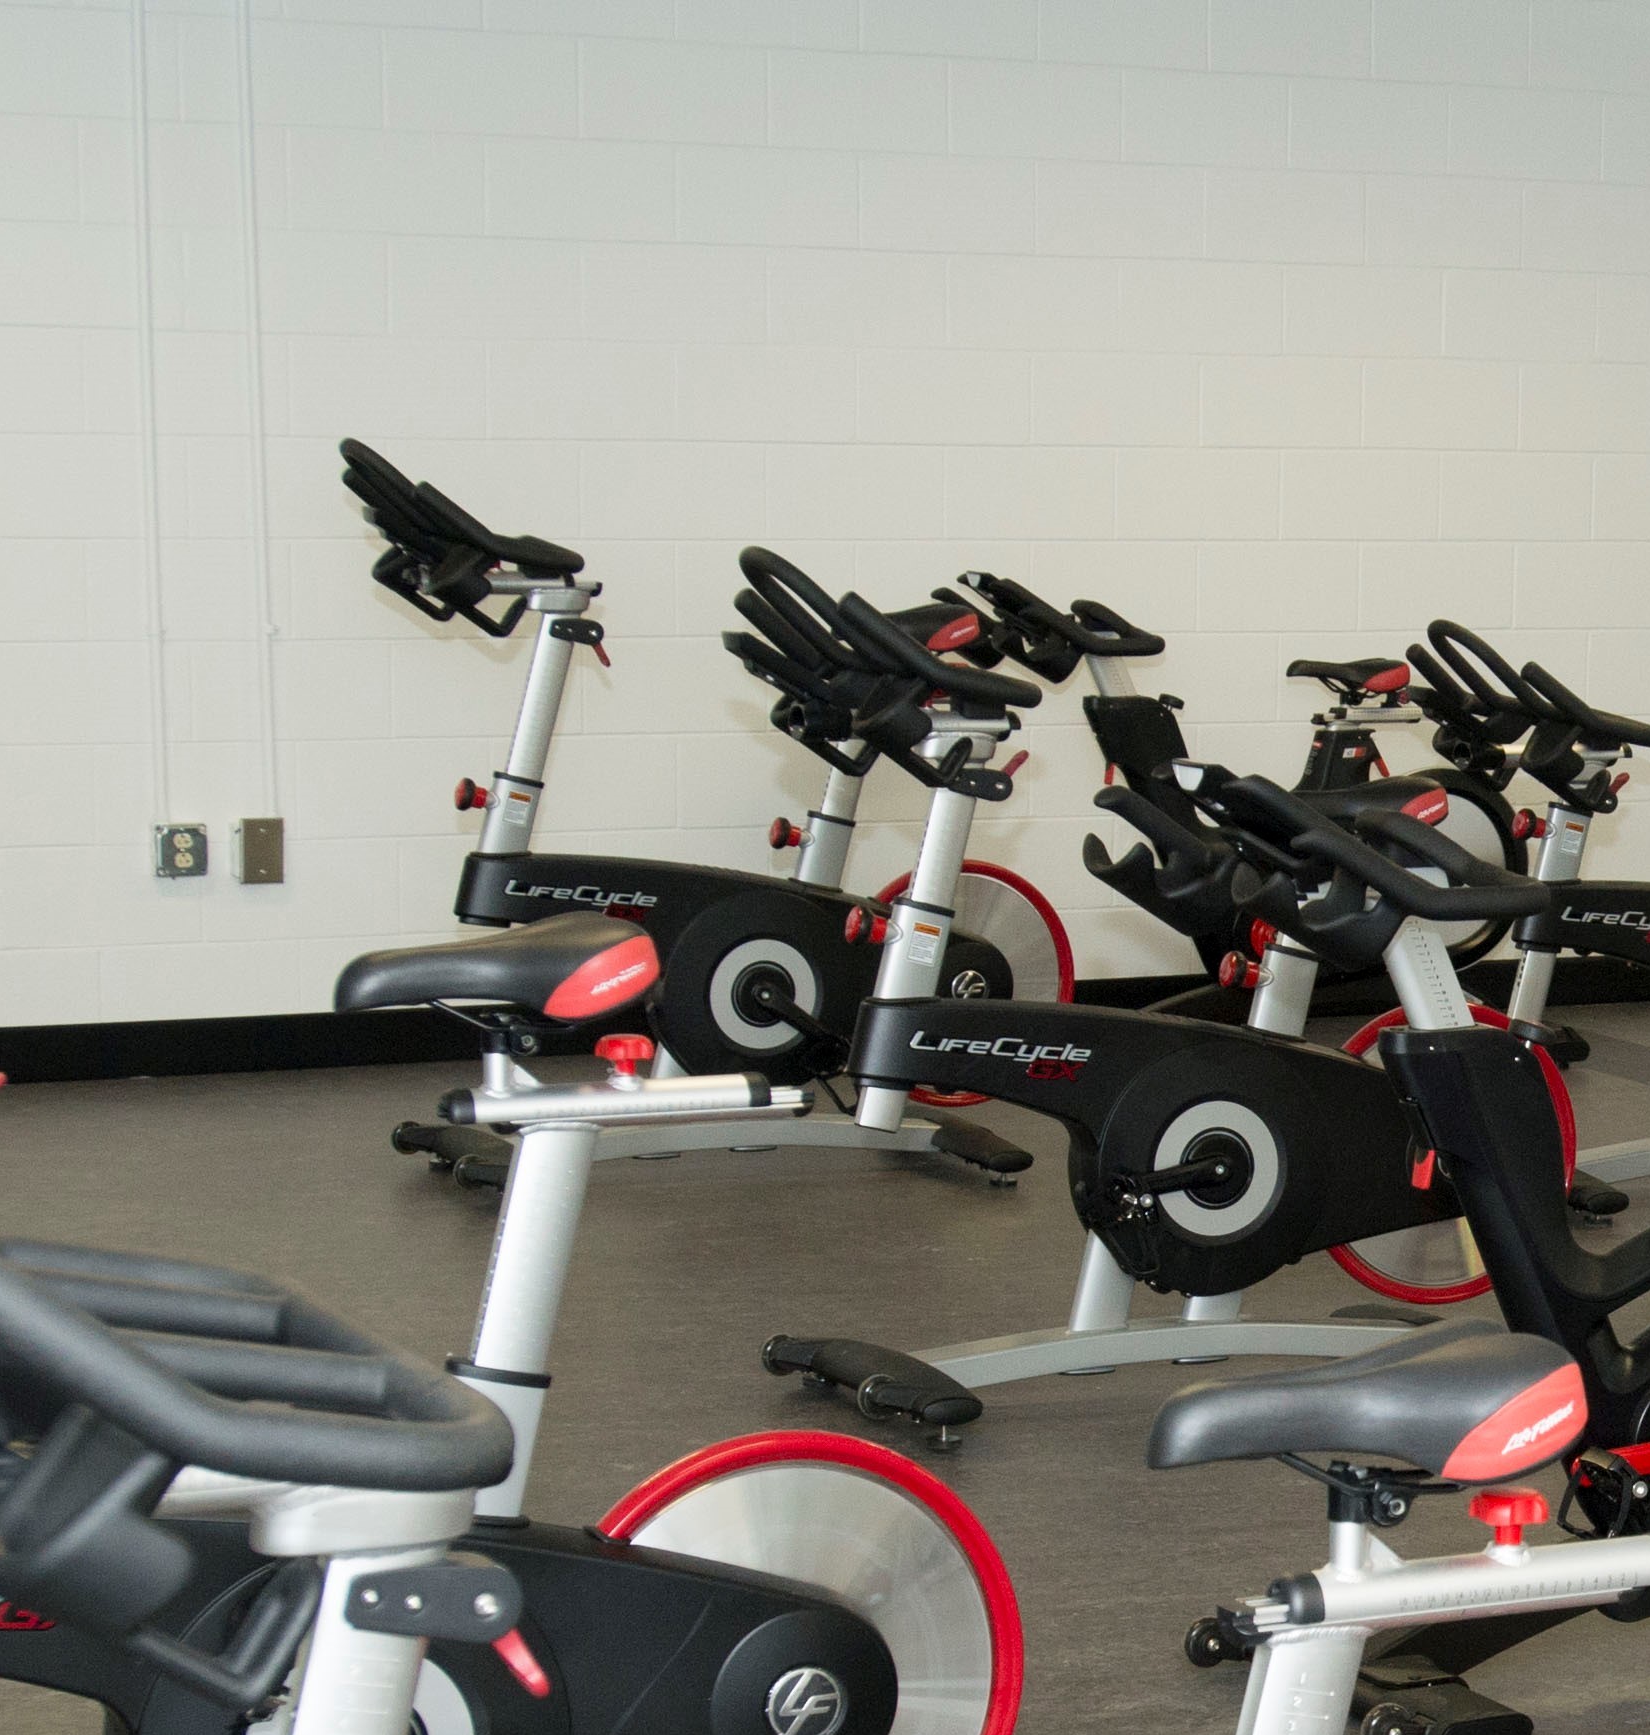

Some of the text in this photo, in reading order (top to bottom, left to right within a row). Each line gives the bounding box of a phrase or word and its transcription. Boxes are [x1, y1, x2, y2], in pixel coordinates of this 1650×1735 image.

[504, 879, 658, 908] LifeCycle
[909, 1030, 1092, 1063] LifeCycle
[1025, 1060, 1086, 1082] GX
